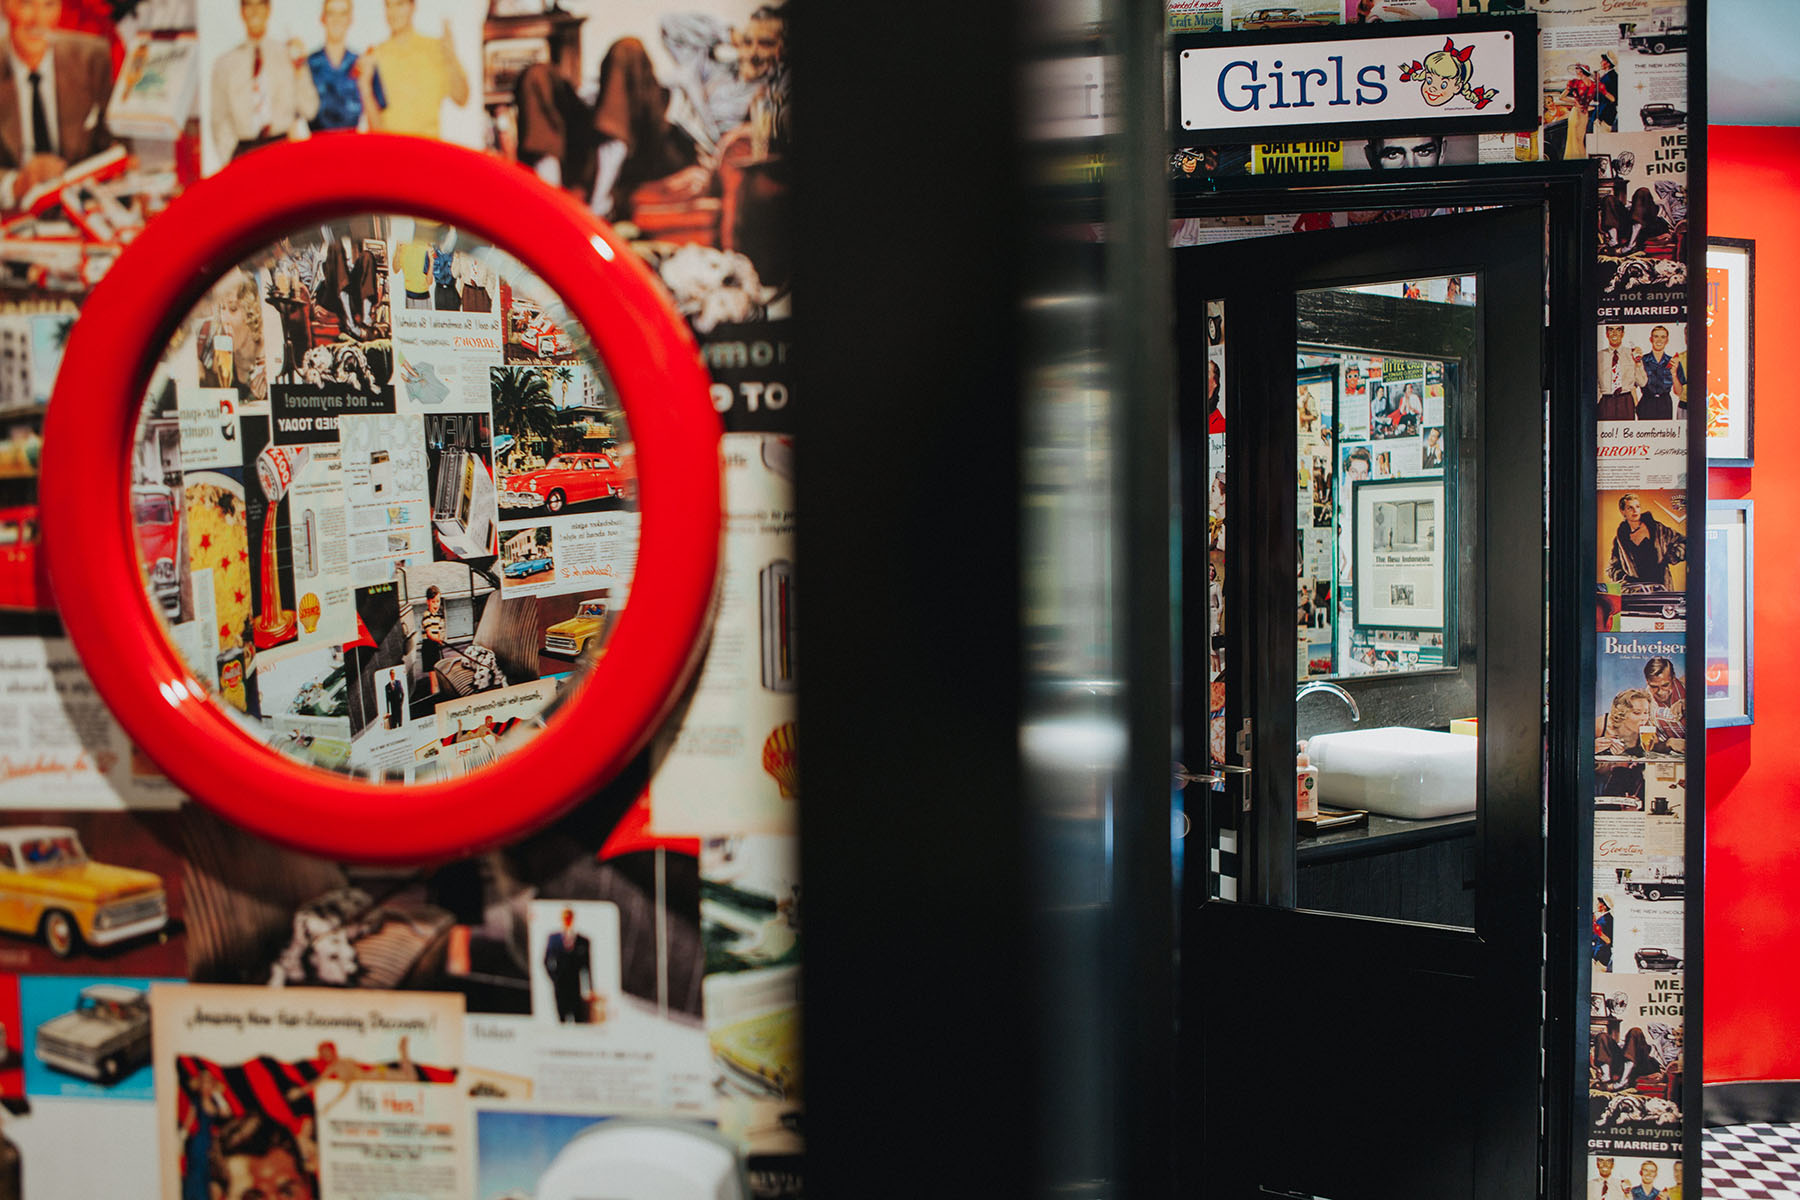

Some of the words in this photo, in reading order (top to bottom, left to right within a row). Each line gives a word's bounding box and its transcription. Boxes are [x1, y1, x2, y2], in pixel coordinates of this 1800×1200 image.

[1169, 14, 1192, 27] Craft
[1217, 55, 1389, 112] Girls
[1262, 155, 1330, 174] WINTER
[1620, 292, 1642, 301] not
[1597, 307, 1621, 317] GET
[1623, 306, 1679, 316] MARRIED
[1600, 427, 1619, 438] cool!
[1623, 427, 1634, 438] Be
[1636, 426, 1681, 438] comfortable!
[1604, 635, 1686, 654] Budweiser
[1648, 992, 1684, 1004] LIFT
[1610, 1126, 1633, 1135] not
[1587, 1139, 1612, 1149] GET
[1614, 1140, 1669, 1151] MARRIED
